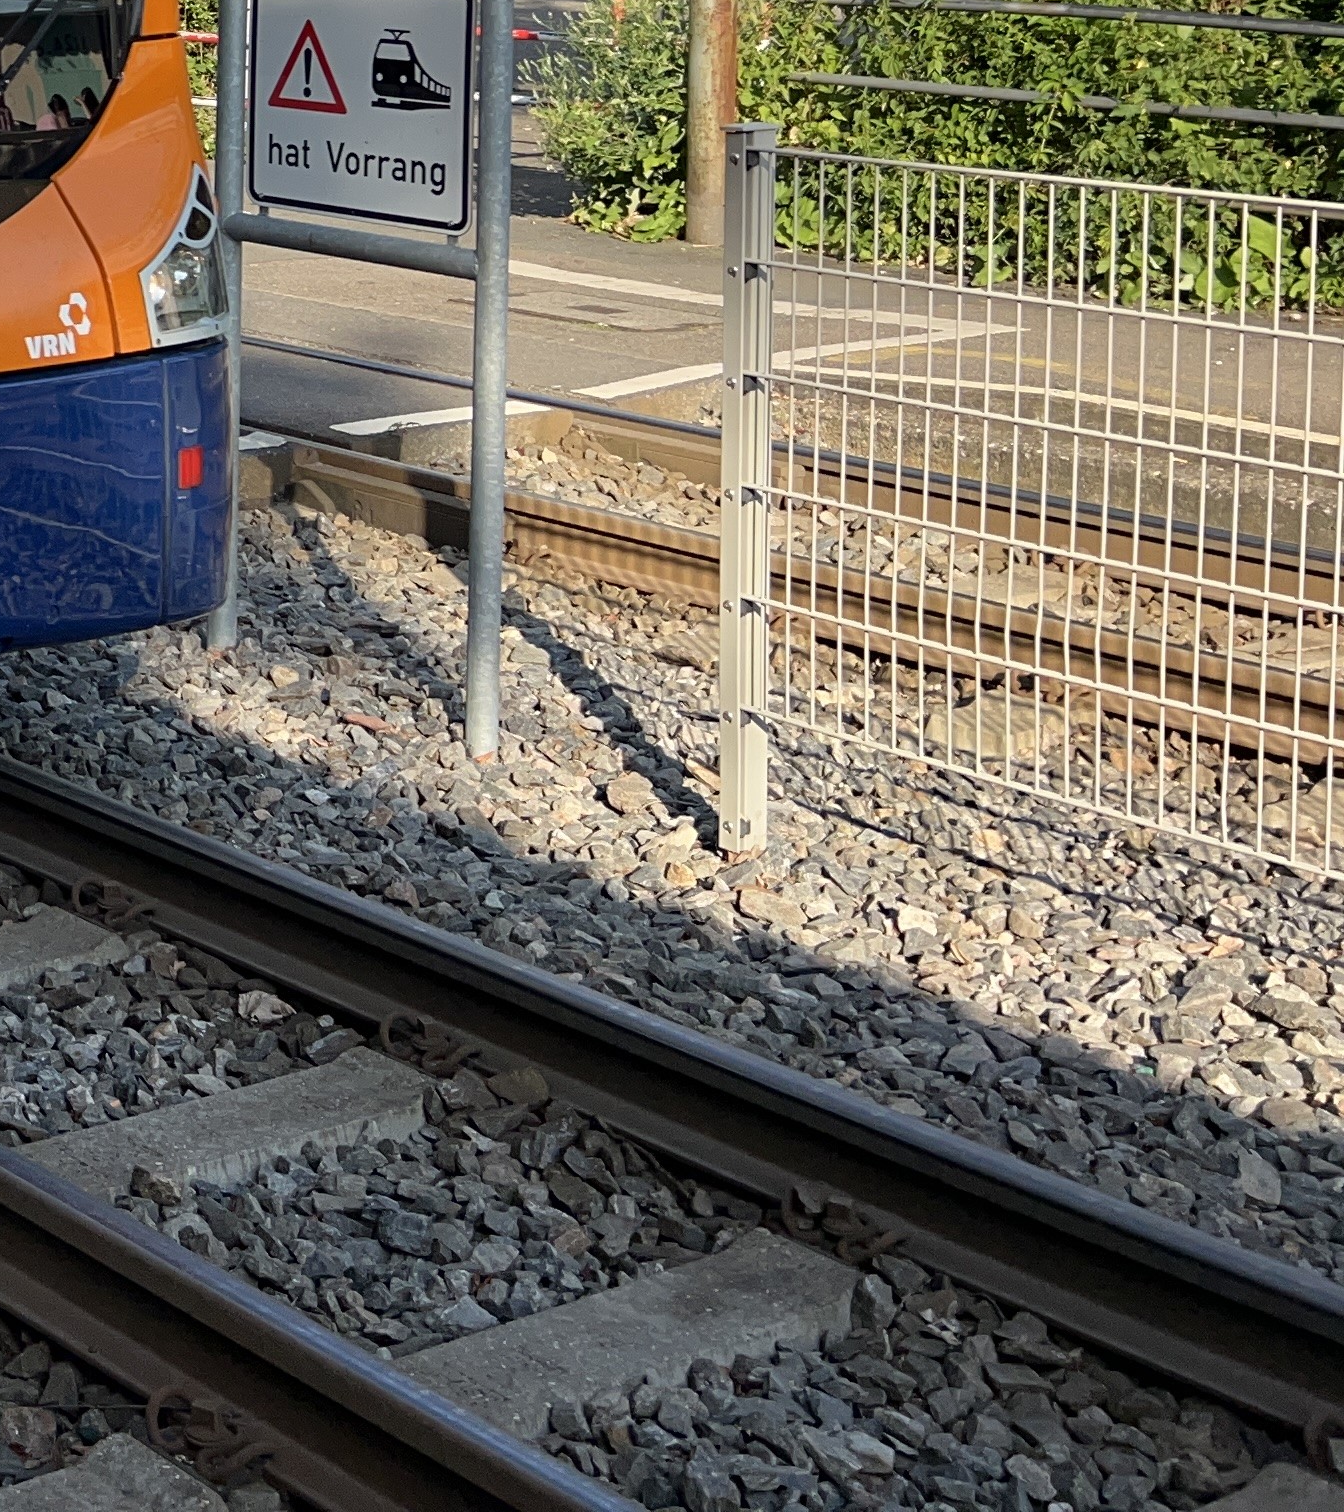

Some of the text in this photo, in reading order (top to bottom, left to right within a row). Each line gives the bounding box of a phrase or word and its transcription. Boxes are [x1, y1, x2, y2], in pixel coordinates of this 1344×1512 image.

[268, 134, 446, 195] hat Vorrang
[24, 329, 77, 359] VRN
